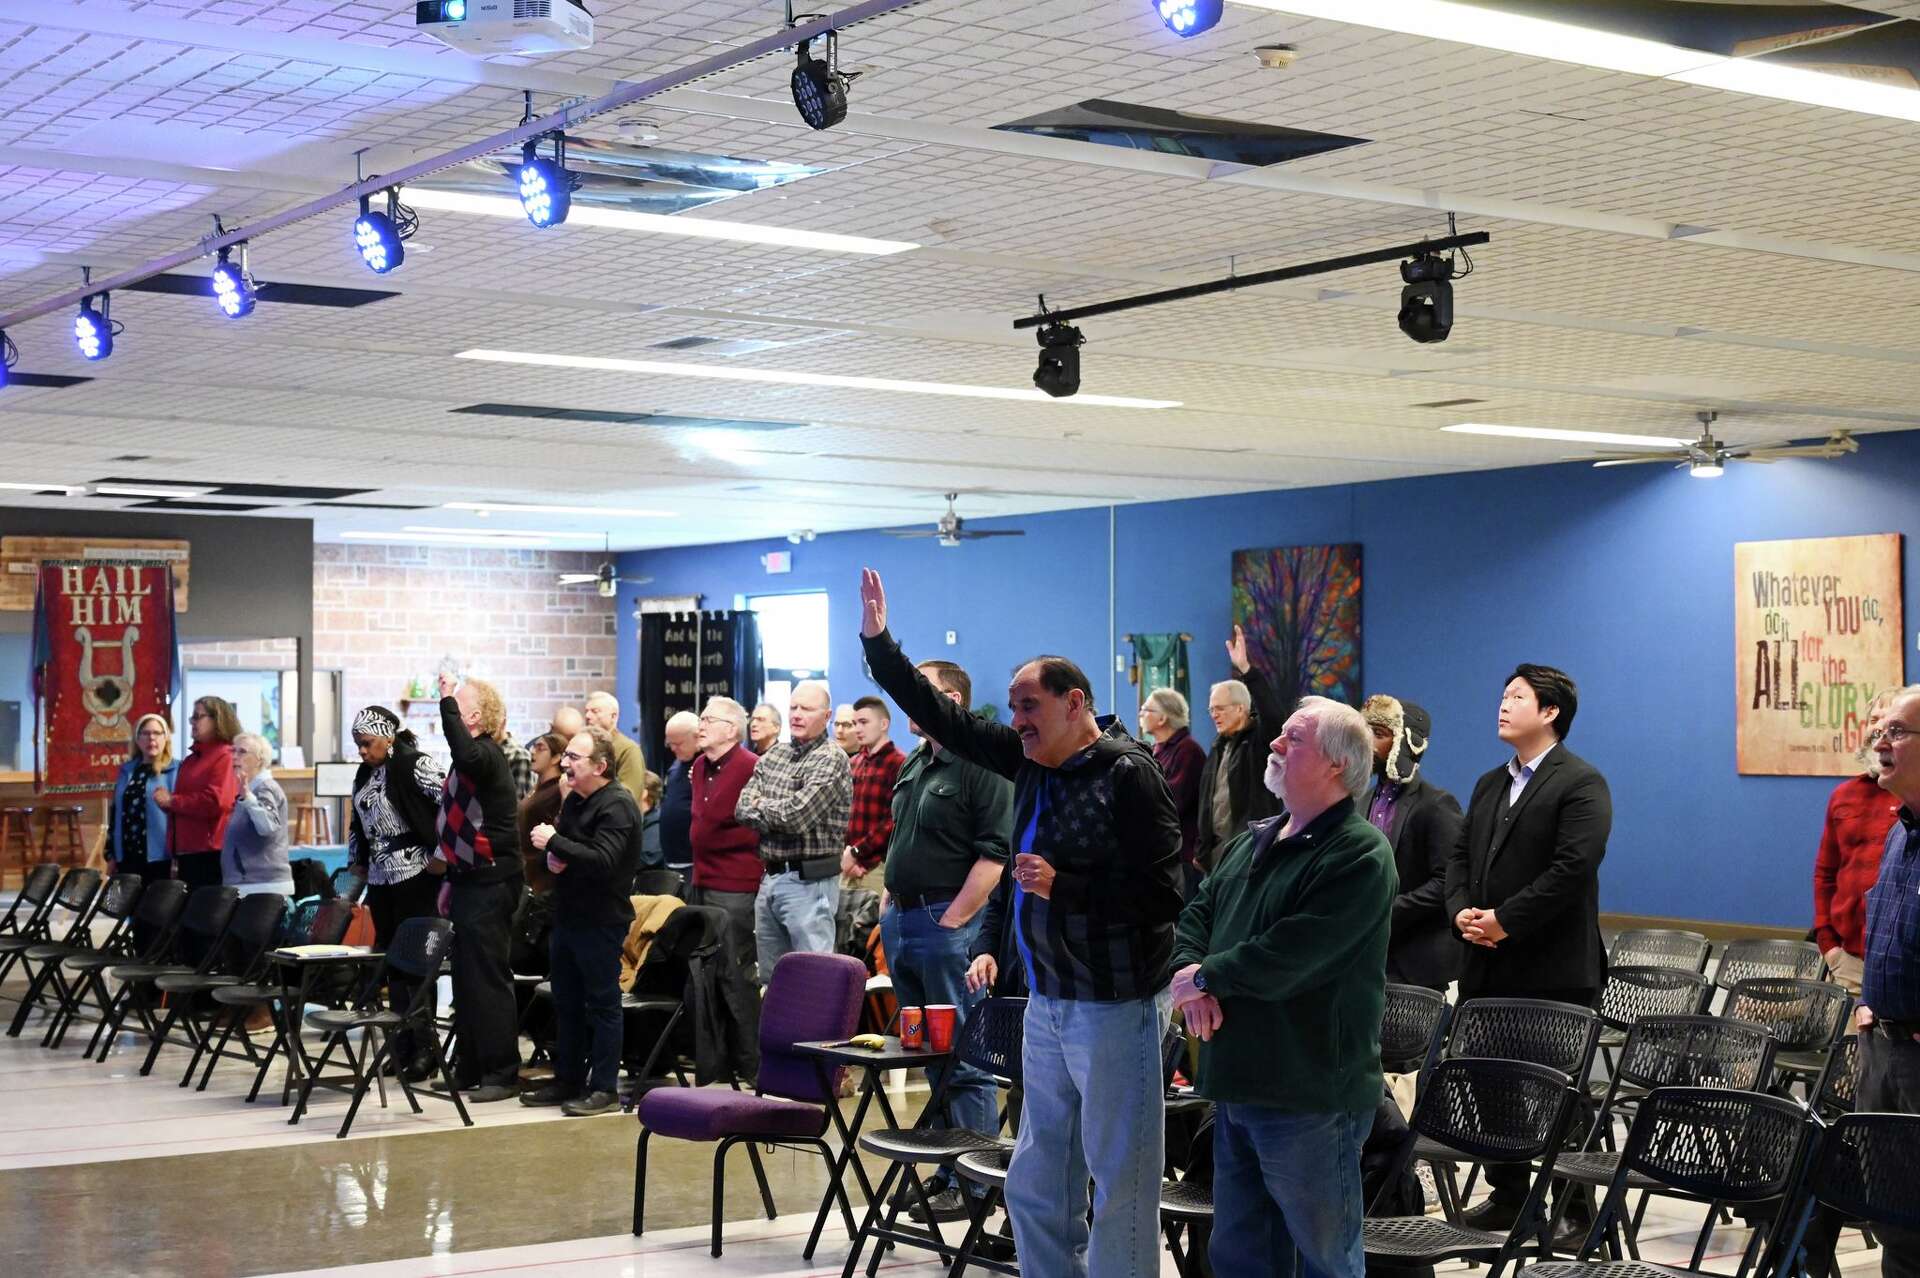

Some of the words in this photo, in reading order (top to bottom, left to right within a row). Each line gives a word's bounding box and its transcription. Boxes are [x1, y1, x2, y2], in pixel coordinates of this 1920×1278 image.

[60, 566, 151, 595] HAIL
[1753, 570, 1841, 608] Whatever
[69, 596, 143, 625] HIM
[1765, 610, 1779, 635] do
[1781, 617, 1790, 642] it
[1823, 597, 1861, 635] YOU
[1801, 631, 1824, 664] for
[1753, 640, 1808, 711] ALL
[1821, 654, 1848, 687] the
